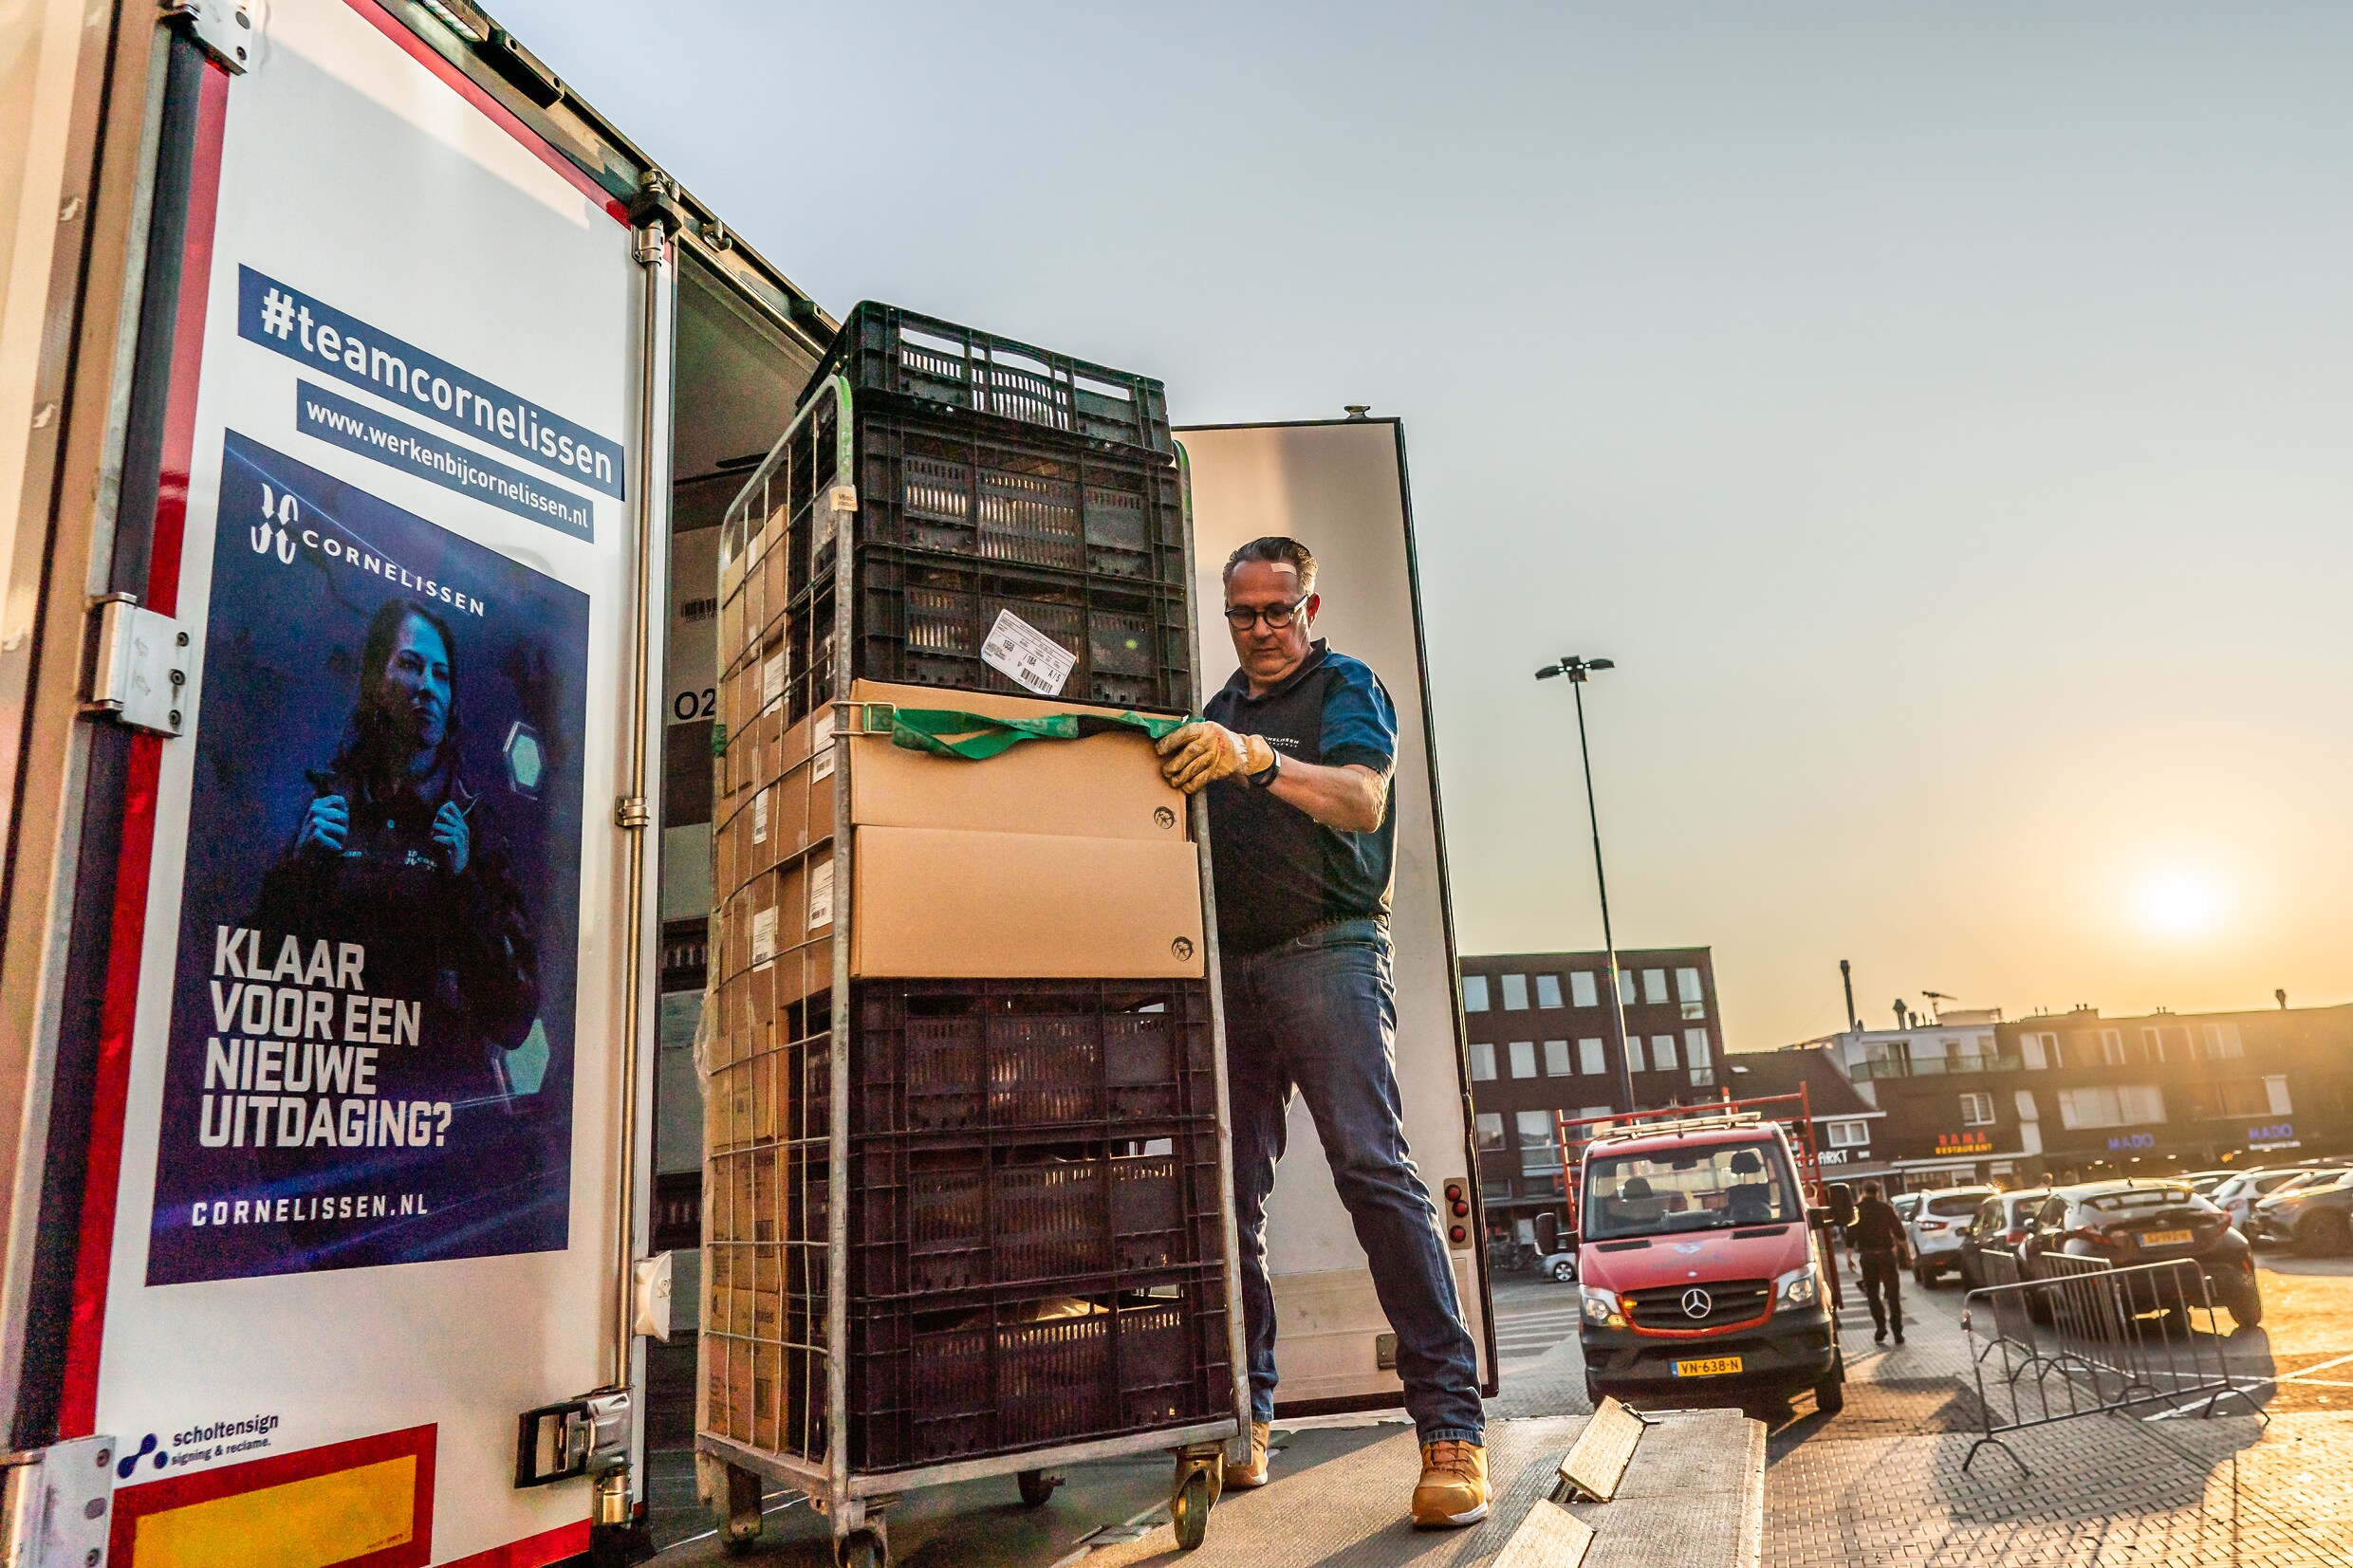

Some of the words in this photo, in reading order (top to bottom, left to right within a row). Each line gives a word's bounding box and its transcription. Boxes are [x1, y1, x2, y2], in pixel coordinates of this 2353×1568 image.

[262, 287, 612, 483] #teamcornelissen
[306, 399, 588, 528] www.werkenbijcornelissen.nl
[302, 529, 485, 617] CORNELISSEN
[213, 925, 365, 991] KLAAR
[210, 980, 334, 1040] VOOR
[343, 994, 421, 1046] EEN
[203, 1037, 379, 1095] NIEUWE
[199, 1095, 453, 1148] UITDAGING?
[2107, 1133, 2156, 1151] MADO
[2248, 1122, 2294, 1140] MADO
[192, 1193, 429, 1227] CORNELISSEN.NL
[1680, 1358, 1739, 1374] VN-638-N
[171, 1448, 212, 1467] signing
[214, 1444, 224, 1457] &
[226, 1437, 272, 1455] reclame.
[173, 1413, 280, 1448] scholtensign
